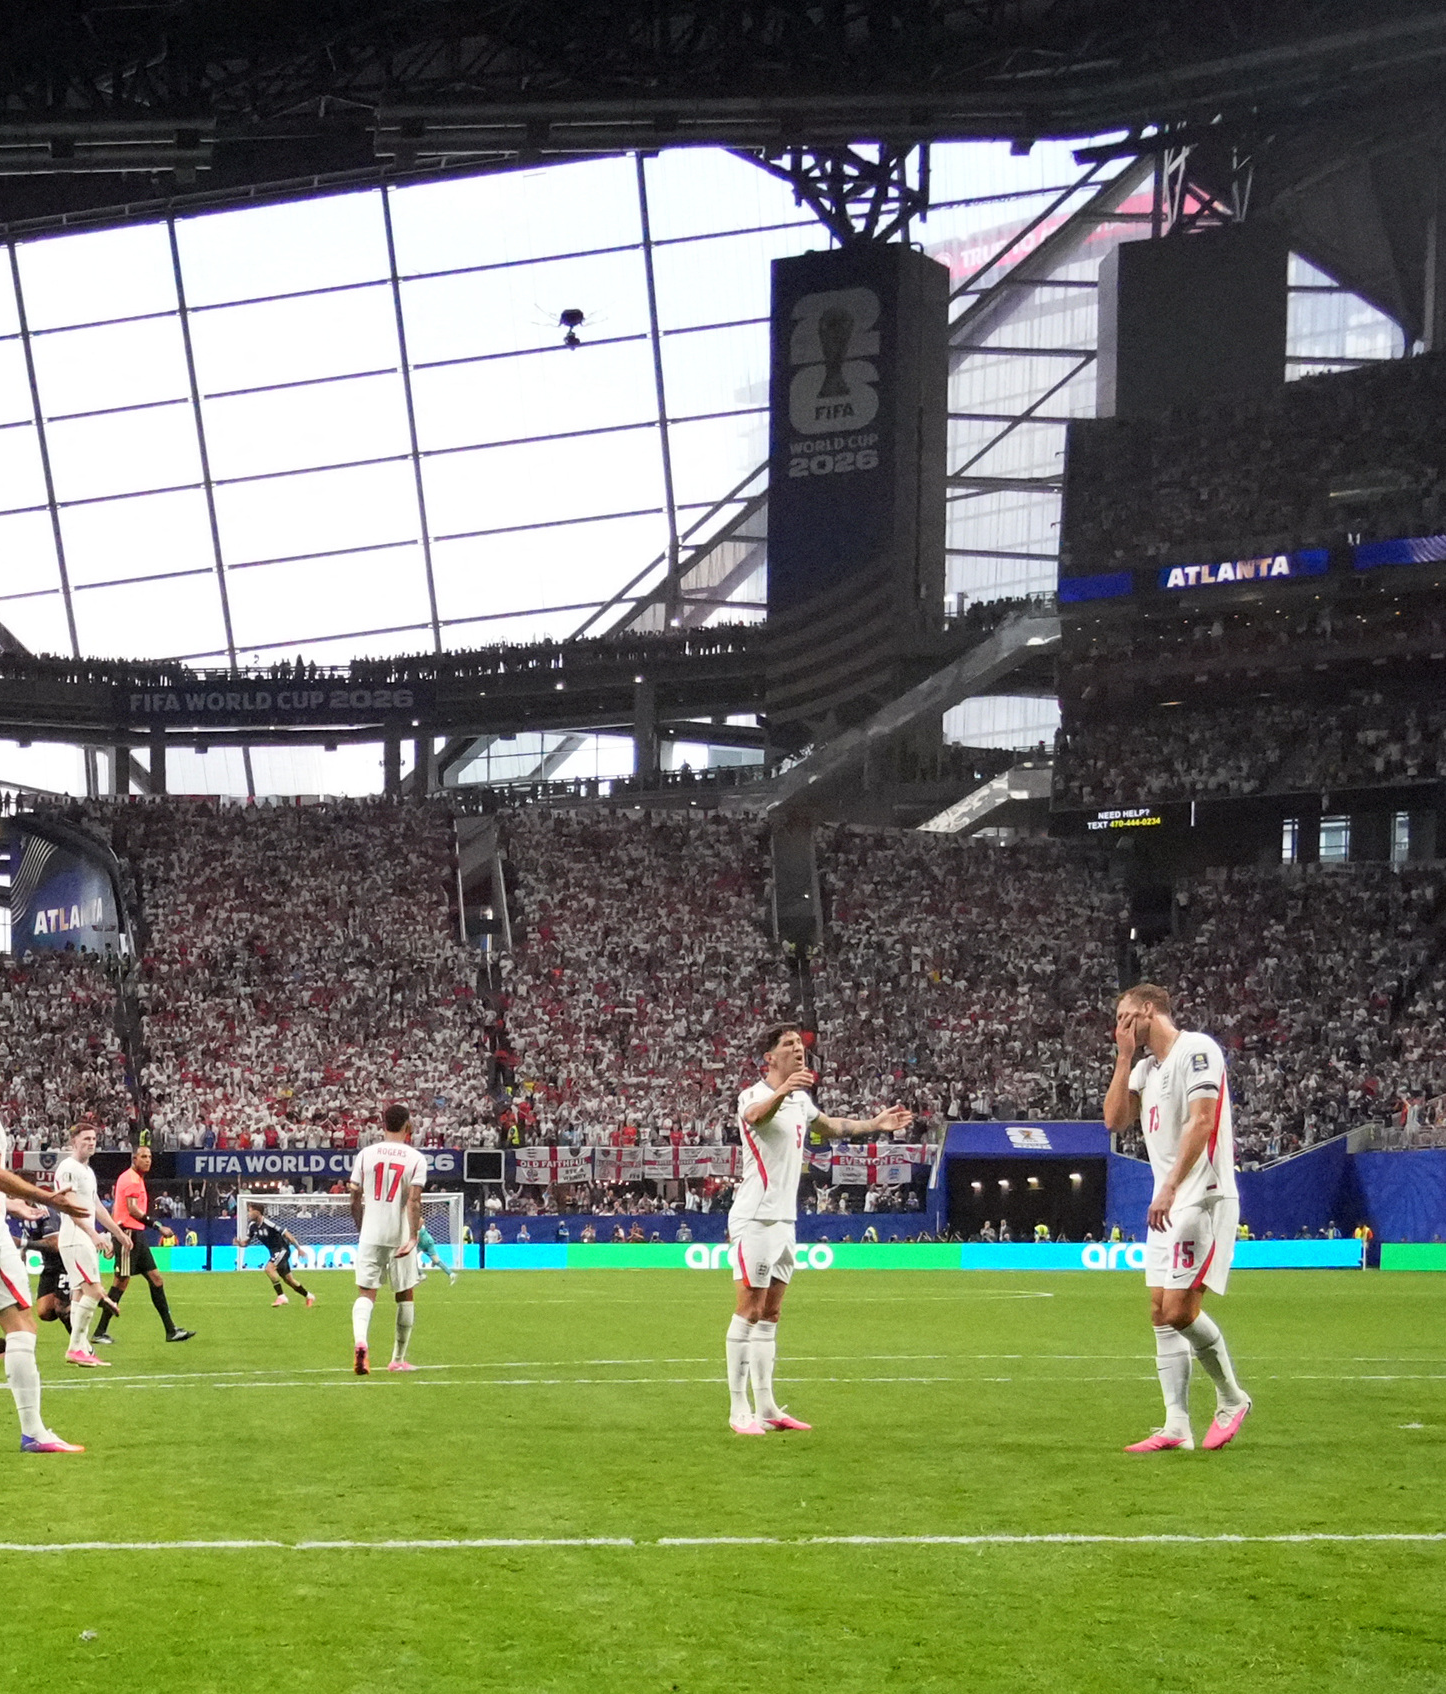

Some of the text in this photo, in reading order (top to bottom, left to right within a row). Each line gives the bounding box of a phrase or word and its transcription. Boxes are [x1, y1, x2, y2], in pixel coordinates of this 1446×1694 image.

[815, 402, 854, 421] FIFA
[789, 432, 879, 455] WORLD CUP
[789, 450, 879, 478] 2026
[1166, 555, 1291, 588] ATLANTA
[129, 689, 414, 712] FIFA WORLD CUP 2026
[1087, 816, 1162, 830] TEXT 470-444-0234
[1097, 808, 1151, 820] NEED HELP?
[796, 1124, 802, 1150] 5
[194, 1155, 243, 1174] FIFA
[246, 1154, 326, 1173] WORLD
[328, 1154, 355, 1172] CU
[377, 1147, 408, 1158] ROGERS
[520, 1160, 540, 1168] OLD
[541, 1158, 588, 1168] FAITHFUL
[839, 1155, 904, 1166] EVERTON FC
[373, 1161, 406, 1203] 17
[684, 1243, 834, 1270] arco
[1172, 1240, 1195, 1269] 15
